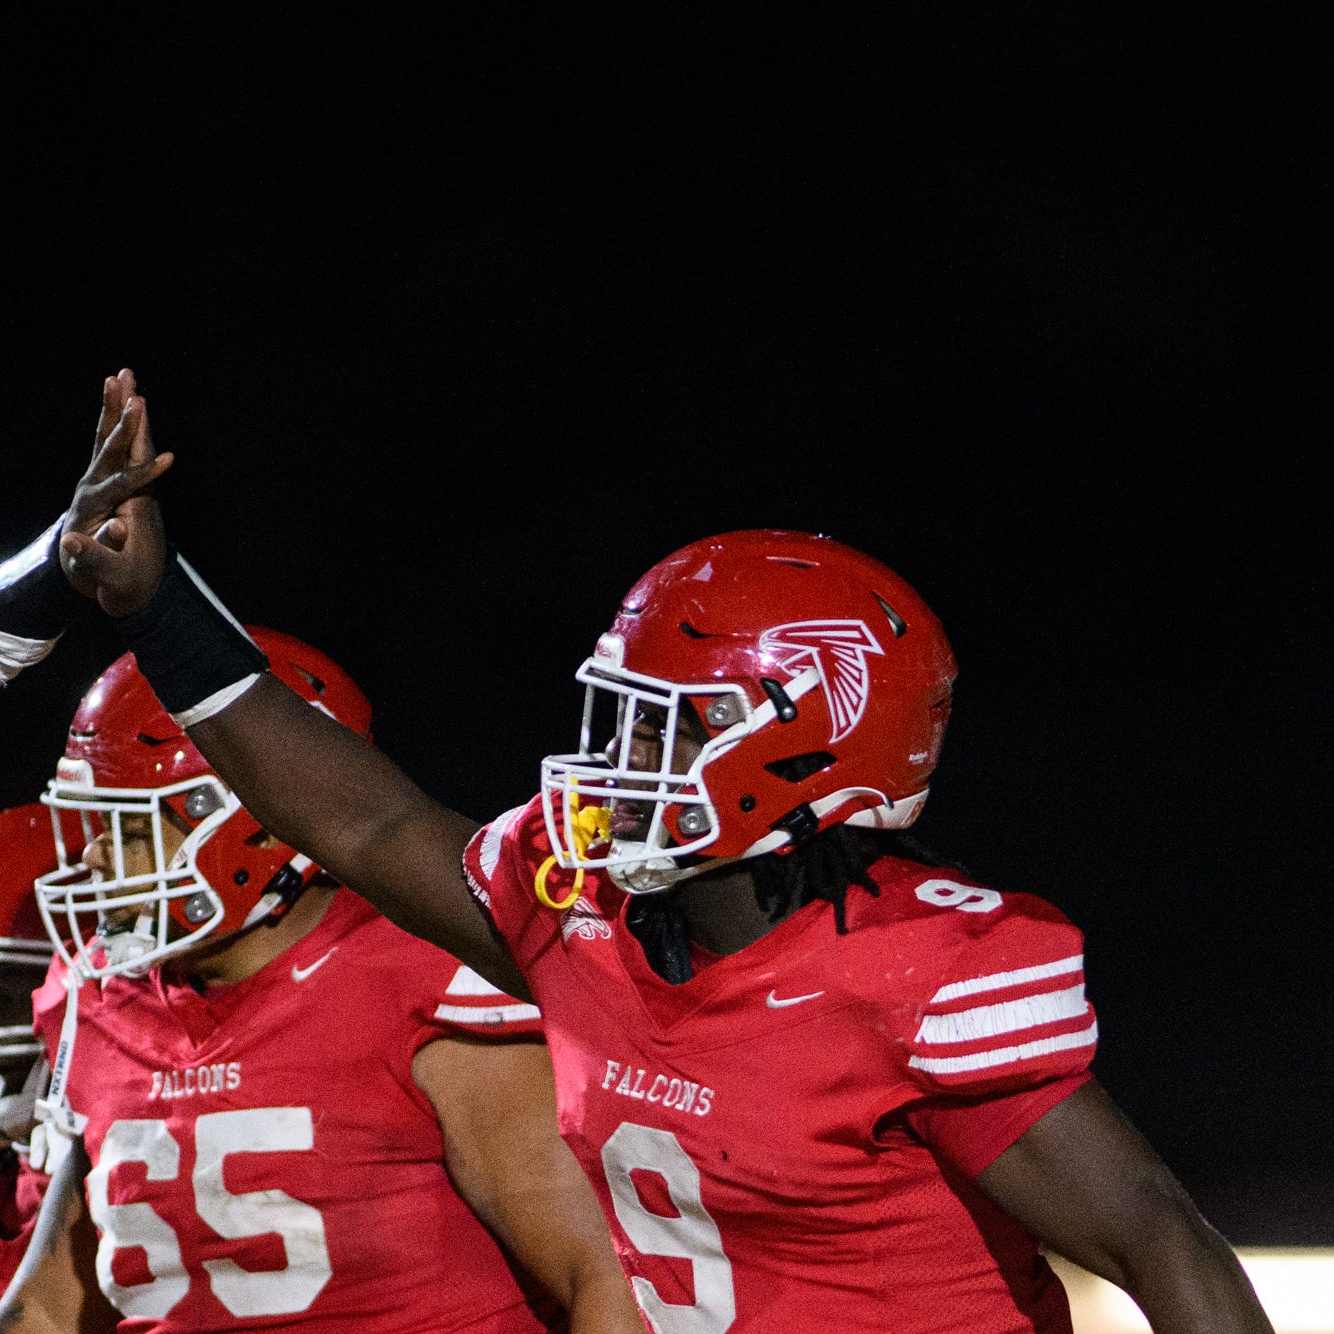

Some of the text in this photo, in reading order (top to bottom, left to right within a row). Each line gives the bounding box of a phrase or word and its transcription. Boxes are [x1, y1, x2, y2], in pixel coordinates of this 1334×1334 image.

[914, 879, 1003, 913] 9
[148, 1062, 241, 1100] FALCONS
[601, 1059, 716, 1117] FALCONS
[86, 1106, 334, 1319] 65
